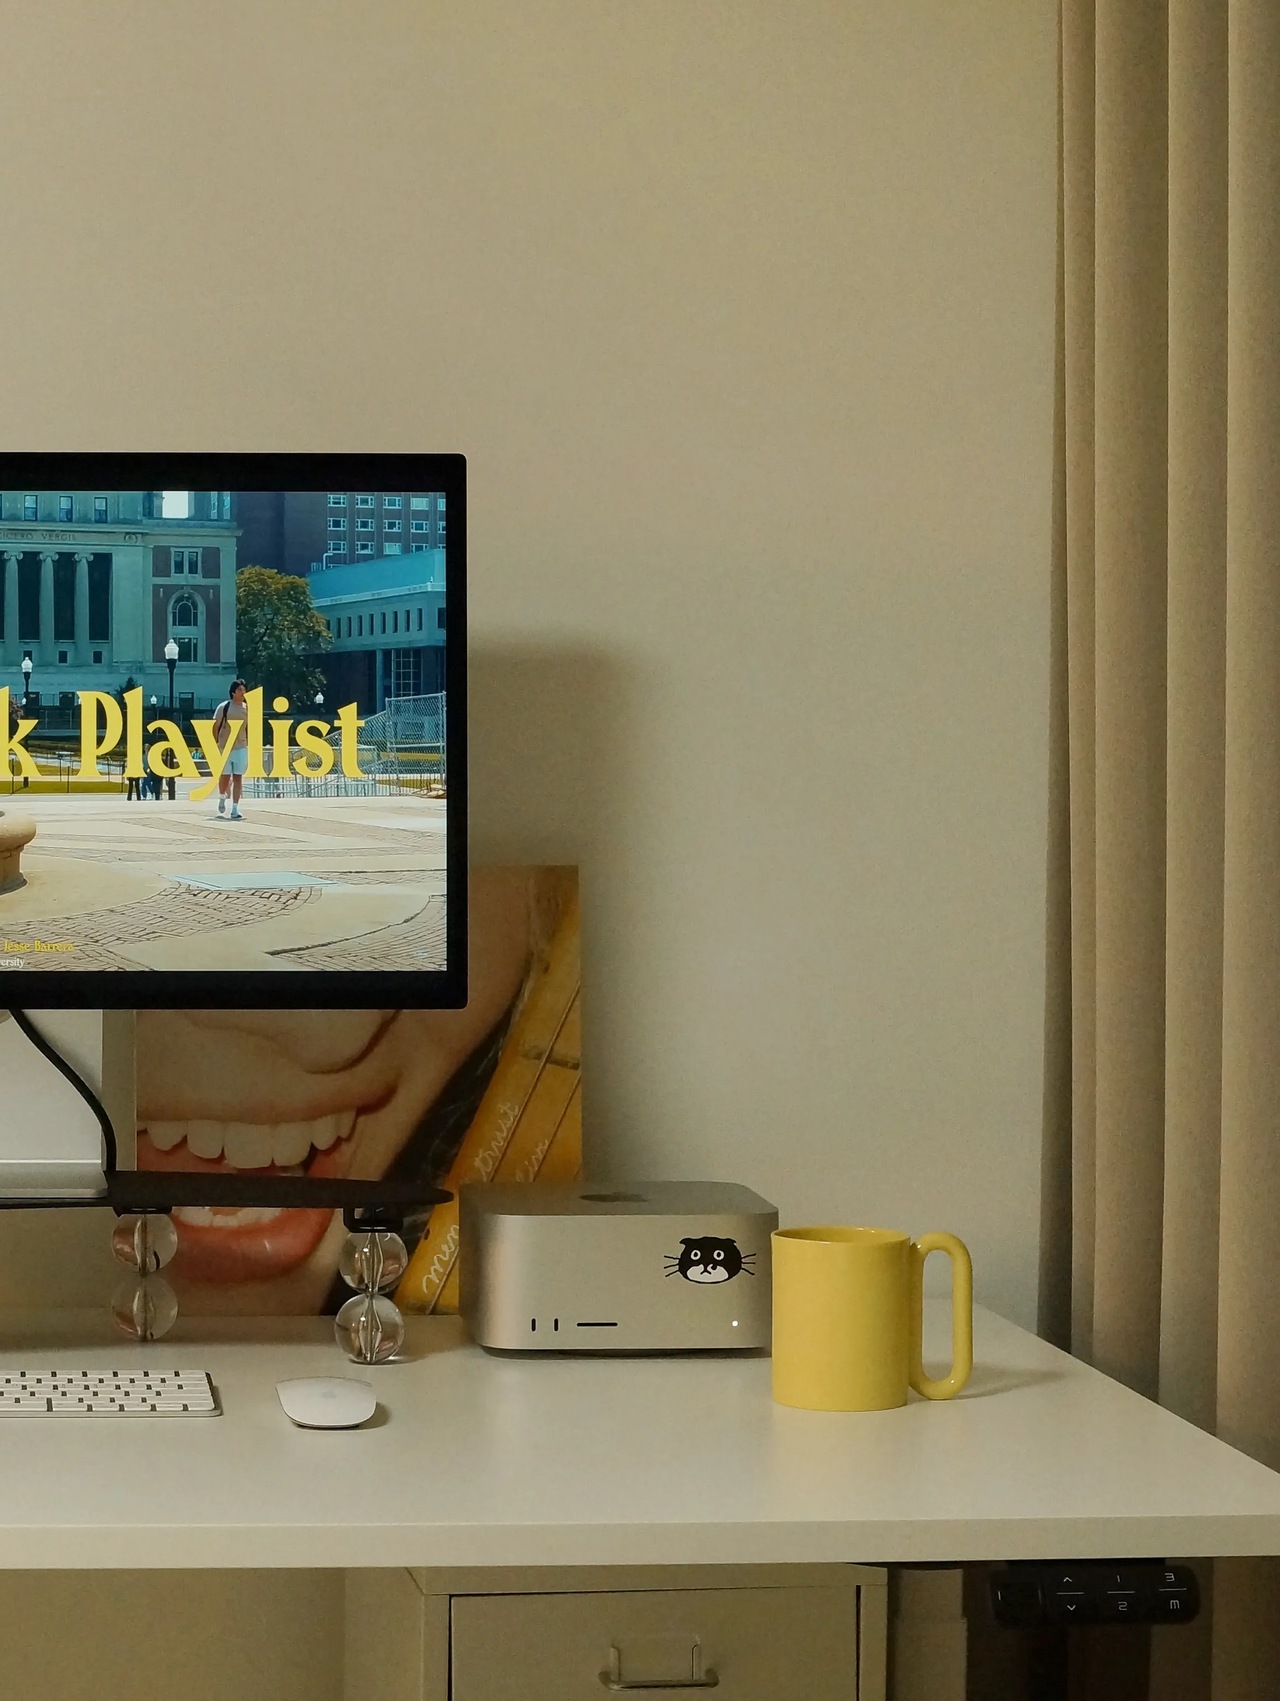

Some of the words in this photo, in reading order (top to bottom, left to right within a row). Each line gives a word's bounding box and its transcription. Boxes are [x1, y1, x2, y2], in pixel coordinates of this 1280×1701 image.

[76, 686, 366, 801] Playlist
[4, 940, 30, 952] Jesse
[1164, 1572, 1175, 1582] 3
[1118, 1601, 1128, 1611] 2
